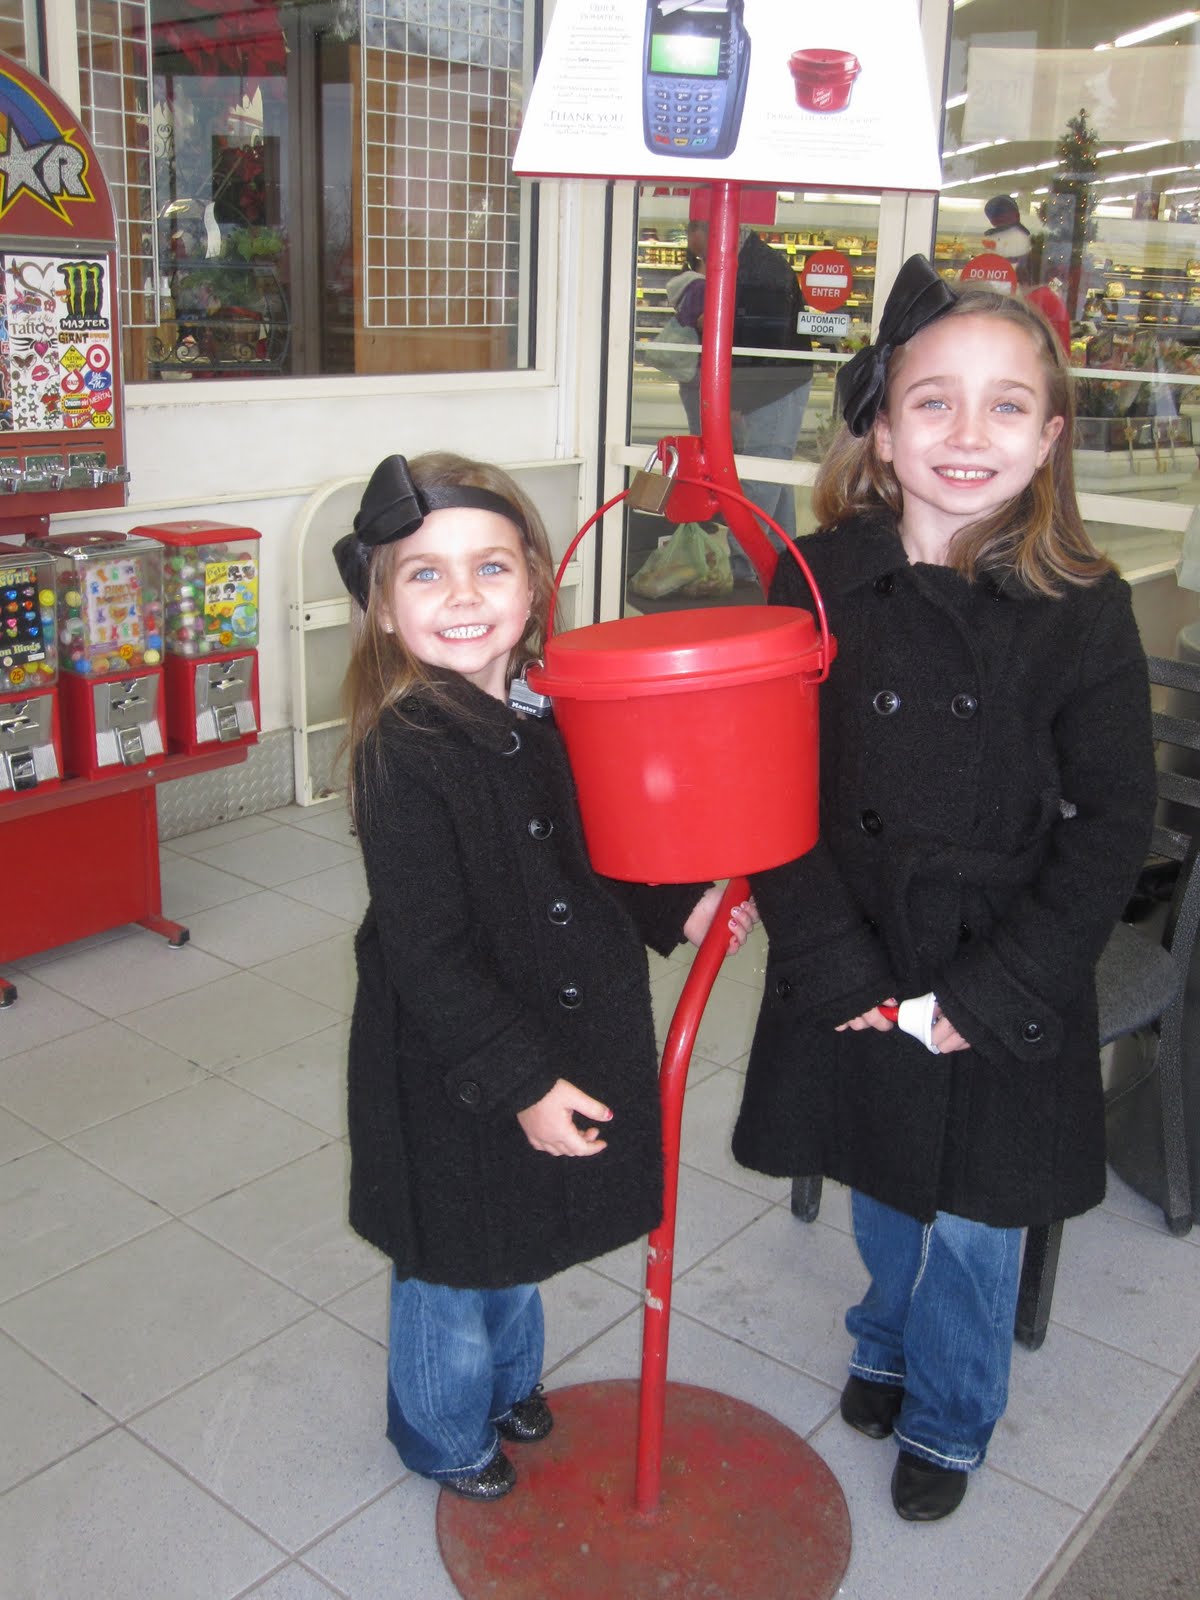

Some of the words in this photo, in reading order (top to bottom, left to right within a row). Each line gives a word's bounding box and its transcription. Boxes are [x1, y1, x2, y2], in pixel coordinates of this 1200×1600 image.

[550, 110, 593, 121] THANK
[811, 264, 824, 273] DO
[825, 264, 844, 274] NOT
[970, 269, 985, 278] DO
[987, 270, 1008, 279] NOT
[811, 288, 840, 297] ENTER
[62, 320, 106, 329] MASTER
[801, 315, 846, 325] AUTOMATIC
[811, 325, 834, 333] DOOR
[92, 415, 110, 424] CD9
[13, 642, 41, 654] Rings
[511, 701, 537, 713] Master
